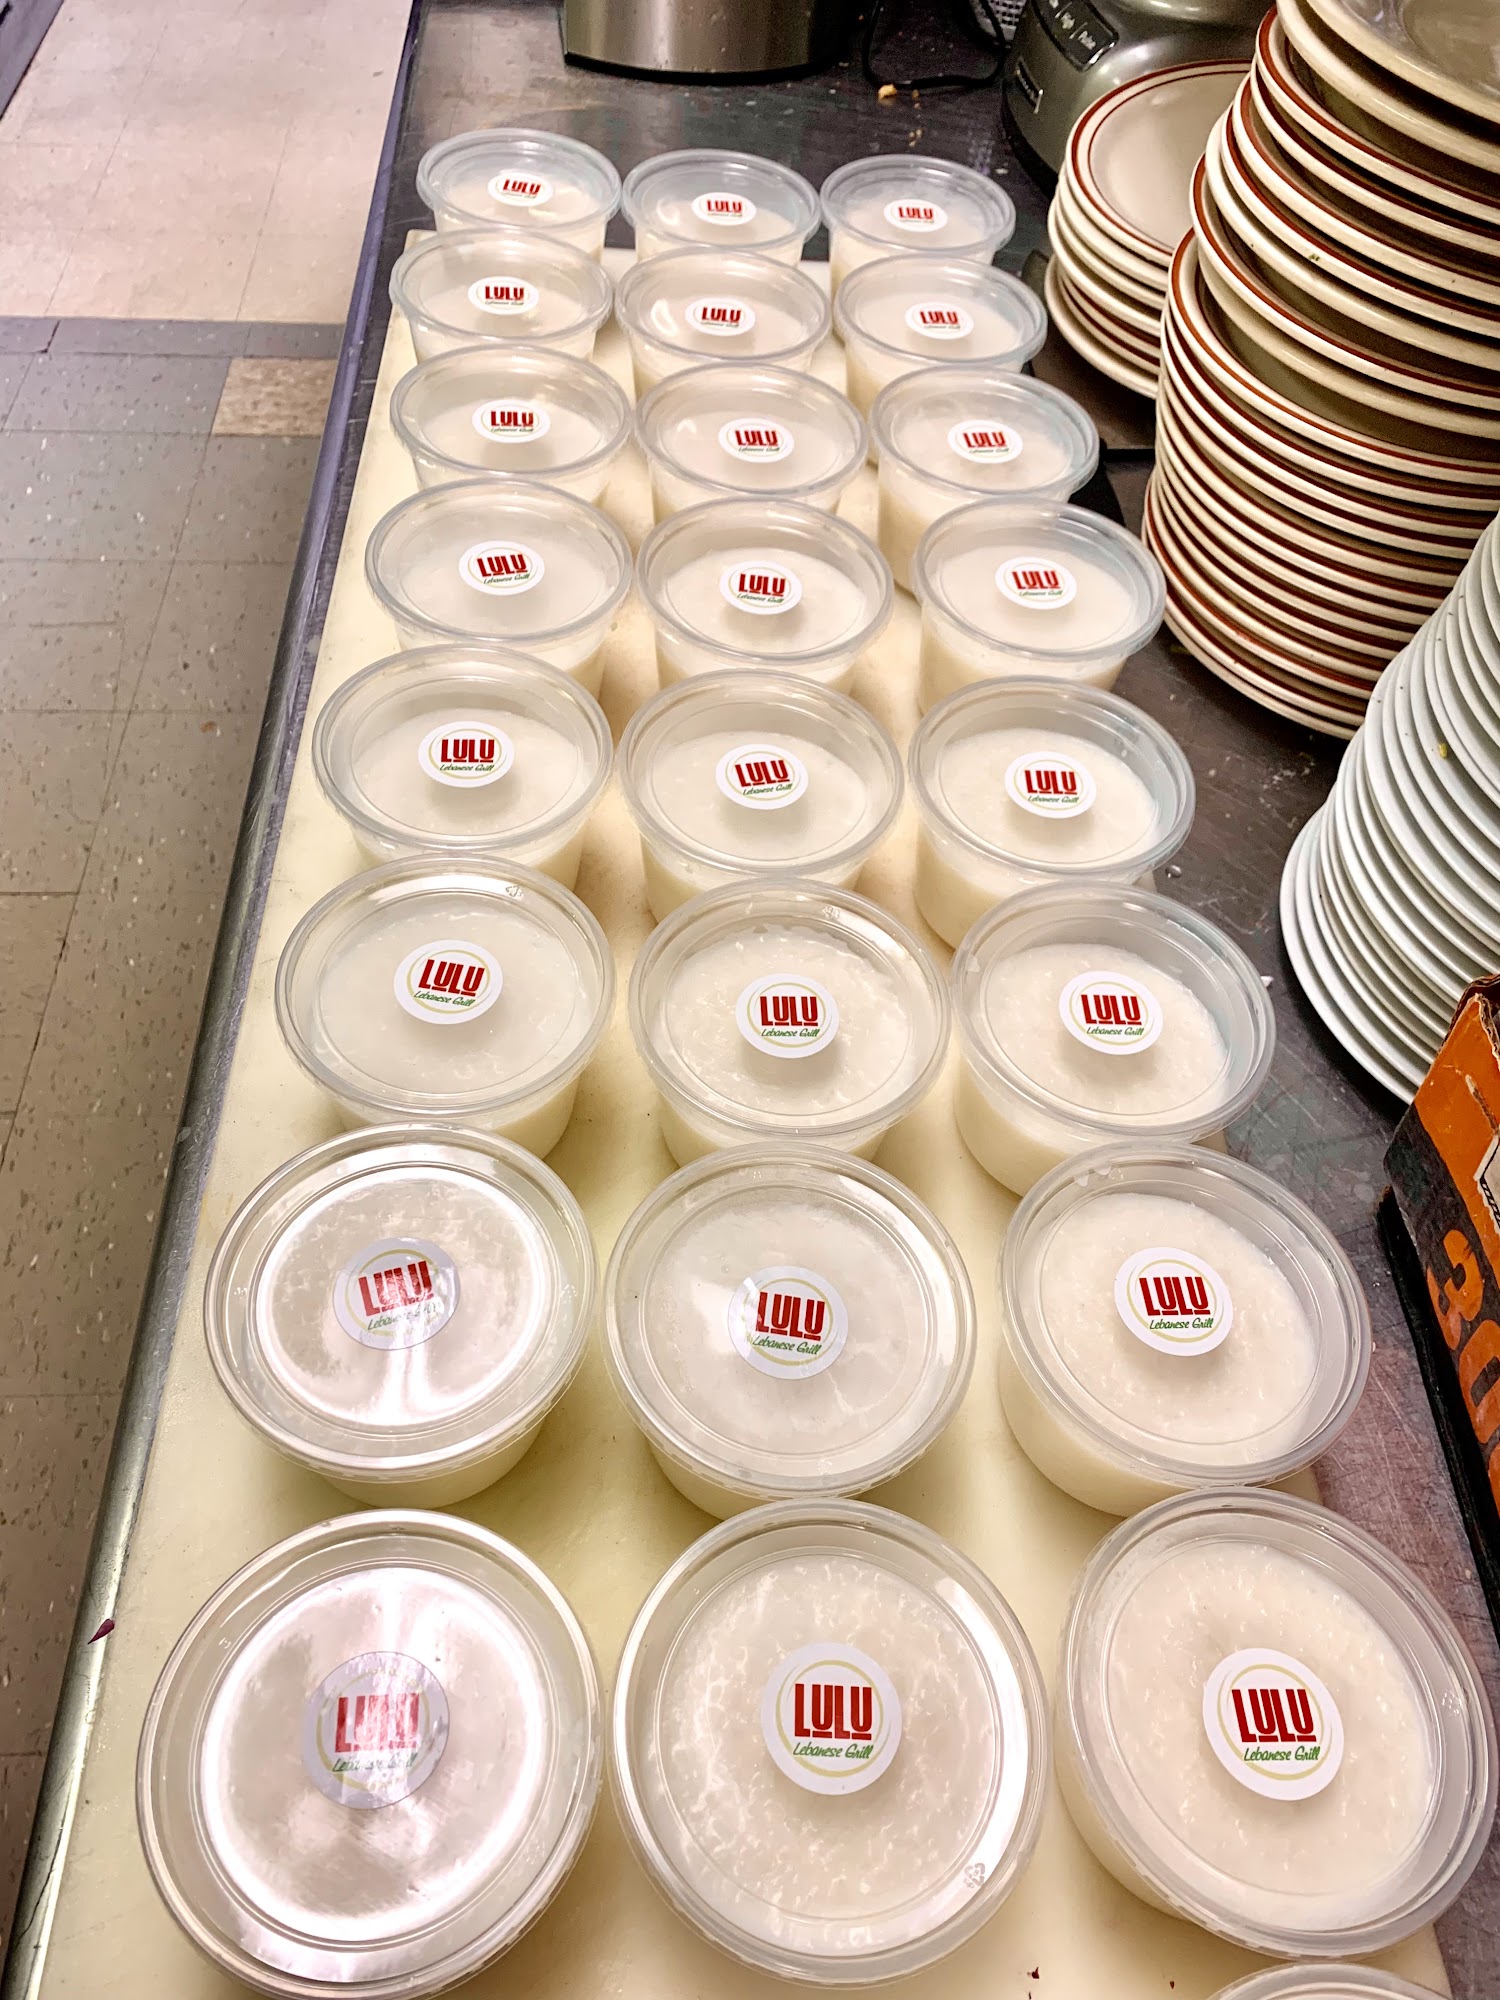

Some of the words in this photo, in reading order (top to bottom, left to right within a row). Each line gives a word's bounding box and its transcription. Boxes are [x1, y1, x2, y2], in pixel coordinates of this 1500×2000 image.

[503, 179, 541, 195] LULU
[707, 200, 742, 213] LULU
[899, 206, 933, 219] LULU
[485, 286, 524, 300] LULU
[702, 307, 741, 323] LULU
[920, 311, 959, 324] LULU
[491, 411, 533, 427] LULU
[735, 430, 778, 446] LULU
[963, 432, 1006, 448] LULU
[477, 554, 528, 577] LULU
[738, 573, 785, 596] LULU
[1011, 571, 1061, 589] LULU
[441, 739, 494, 762] LULU
[734, 759, 790, 787] LULU
[1024, 770, 1077, 795] LULU
[418, 959, 485, 996] LULU
[414, 991, 452, 1002] Lebanese
[453, 996, 475, 1006] Grill
[759, 996, 818, 1027] LULU
[1081, 994, 1142, 1025] LULU
[761, 1028, 798, 1037] Lebanese
[799, 1029, 820, 1038] Grill
[1086, 1026, 1123, 1035] Lebanese
[1124, 1027, 1144, 1036] Grill
[358, 1260, 434, 1316] LULU
[1139, 1276, 1209, 1316] LULU
[756, 1291, 825, 1340] LULU
[1149, 1319, 1191, 1329] Lebanese
[1192, 1318, 1214, 1329] Grill
[752, 1336, 795, 1350] Lebanese
[797, 1341, 822, 1355] Grill
[1426, 1229, 1500, 1521] 30
[794, 1683, 872, 1740] LULU
[1231, 1688, 1317, 1743] LULU
[793, 1741, 843, 1757] Lebanese
[845, 1742, 874, 1759] Grill
[1244, 1747, 1292, 1761] Lebanese
[1295, 1745, 1321, 1761] Grill
